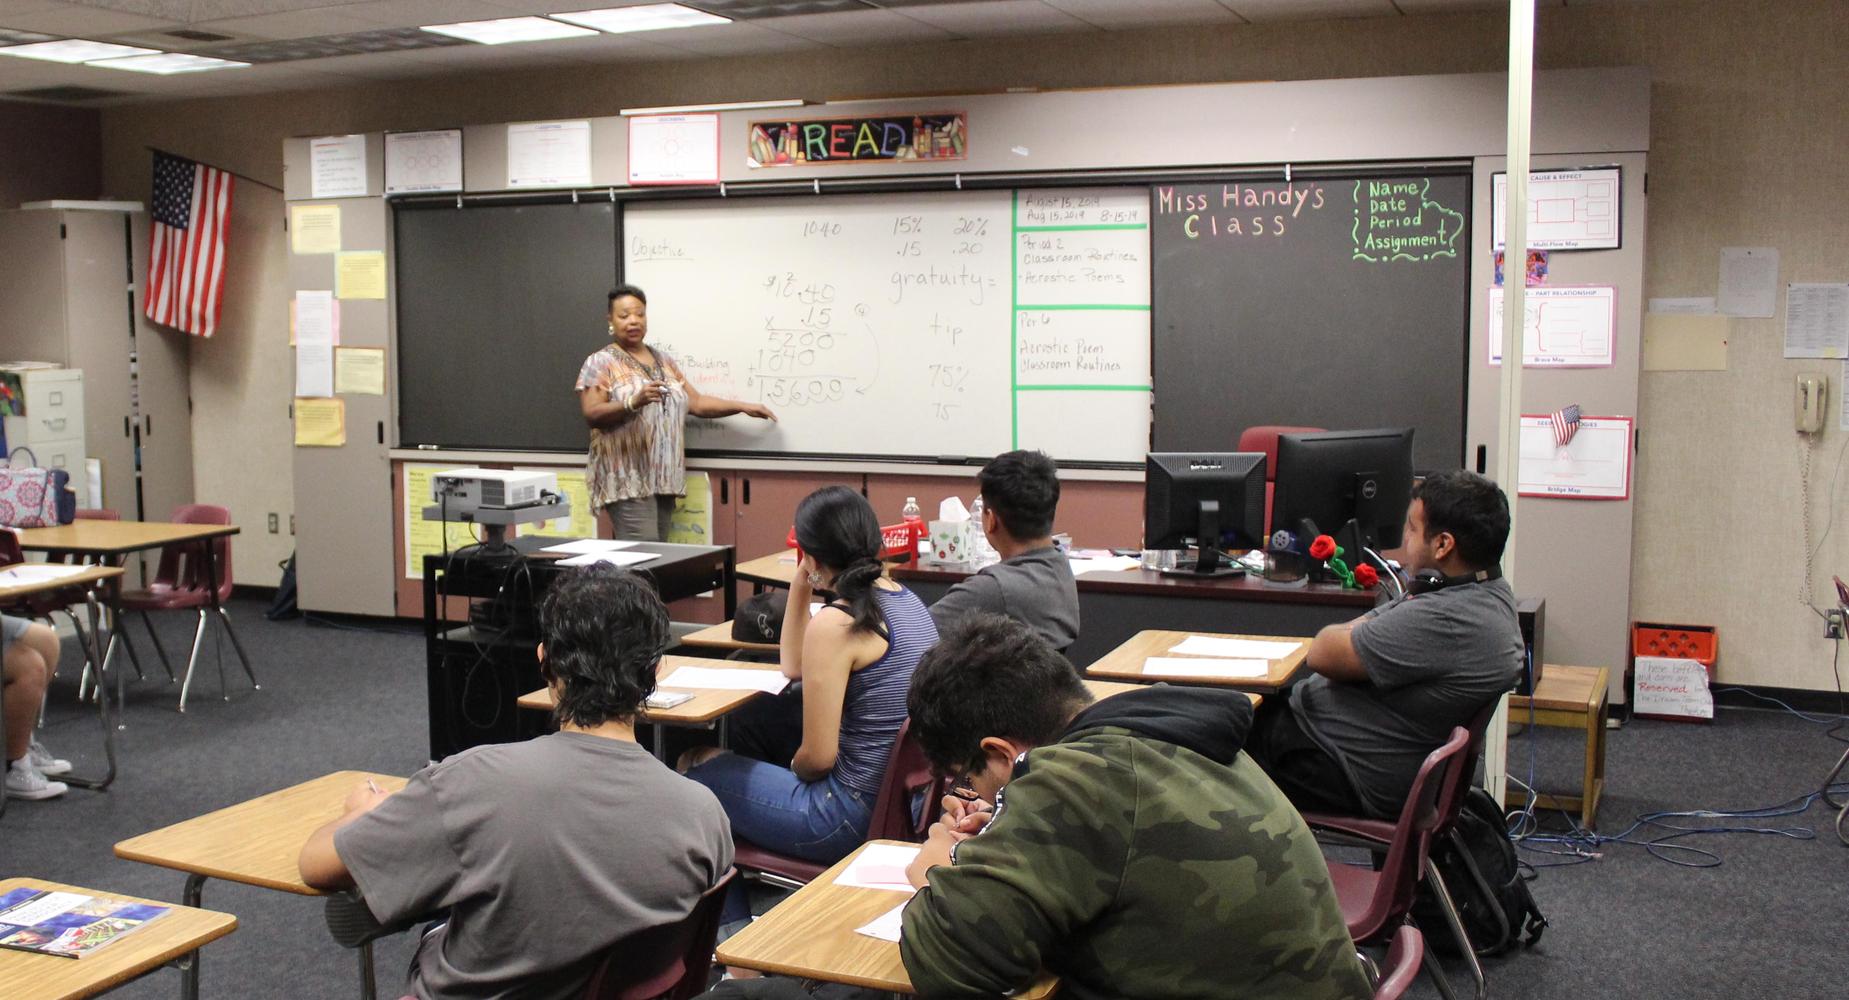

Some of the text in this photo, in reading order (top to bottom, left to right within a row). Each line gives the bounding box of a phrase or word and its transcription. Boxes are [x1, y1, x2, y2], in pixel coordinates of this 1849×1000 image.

[803, 122, 907, 160] READ
[1158, 181, 1325, 218] Miss Handy's
[1369, 181, 1419, 198] Name
[1027, 209, 1047, 223] Aug
[1370, 197, 1407, 214] Date
[892, 215, 989, 237] 15% 20%
[1183, 214, 1286, 239] Class
[1370, 208, 1422, 230] Period
[1364, 217, 1447, 252] Assignment
[1023, 253, 1082, 265] Classroom
[928, 311, 963, 347] tip
[686, 356, 729, 376] Building
[1075, 354, 1122, 373] Routines
[927, 363, 970, 393] 75%
[1638, 682, 1688, 694] Reserved
